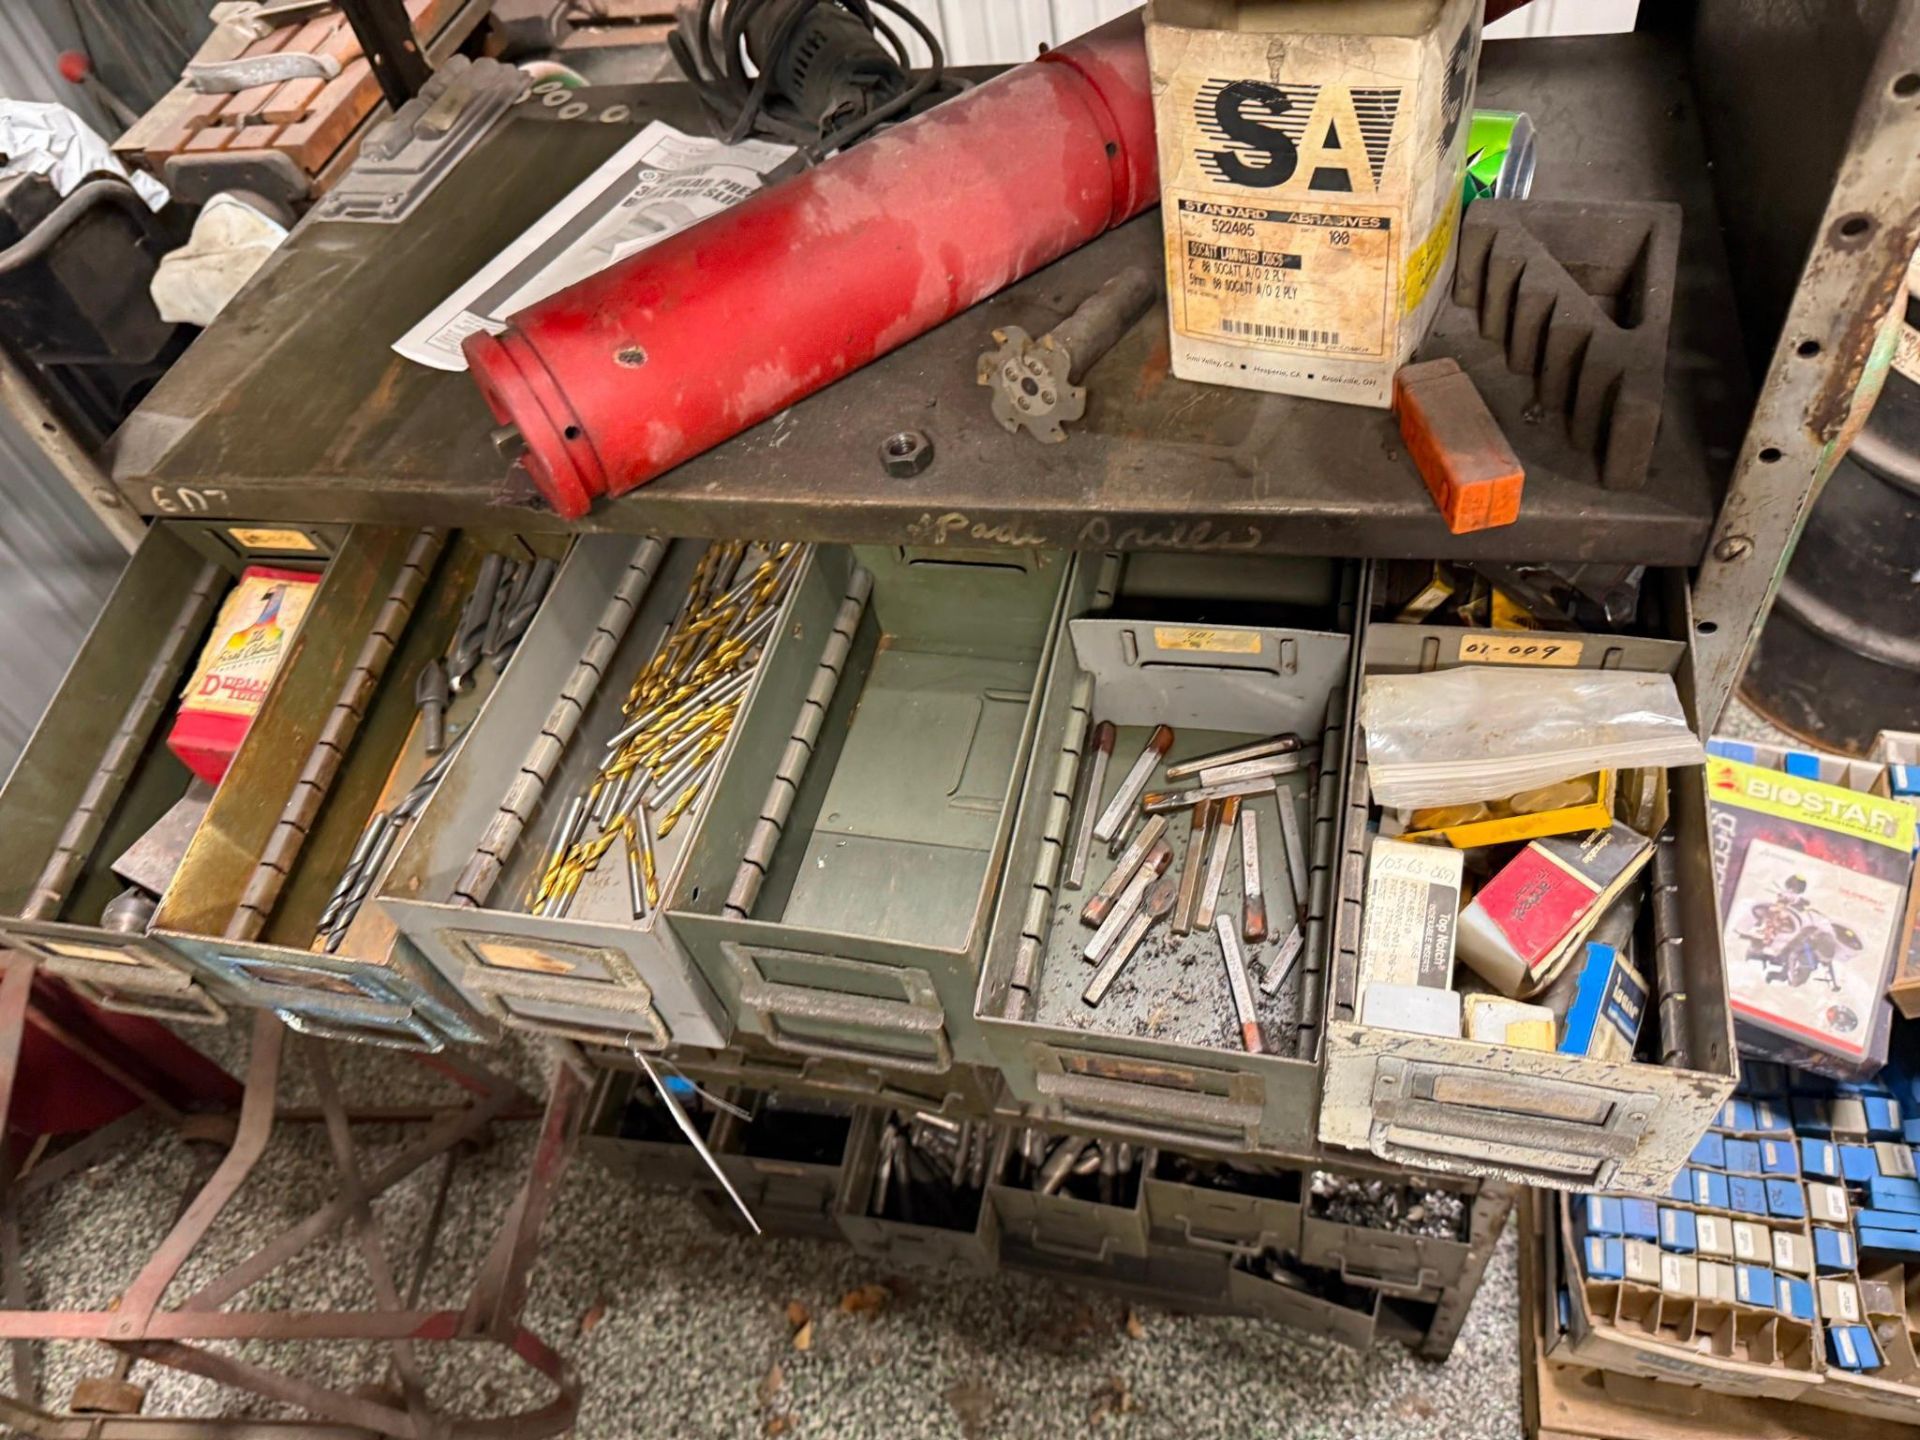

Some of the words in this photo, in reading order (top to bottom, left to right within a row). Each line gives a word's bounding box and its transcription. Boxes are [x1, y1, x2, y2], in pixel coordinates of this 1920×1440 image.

[1194, 79, 1402, 192] SA
[1184, 200, 1268, 220] STANDARD
[1288, 212, 1382, 229] ABRASIVES
[1329, 231, 1350, 246] 100
[1264, 267, 1271, 280] 2
[1273, 269, 1287, 283] PLY
[1275, 285, 1282, 298] 2
[1283, 287, 1298, 300] PLY
[1746, 778, 1894, 832] BIOSTAR
[1437, 912, 1452, 933] Top
